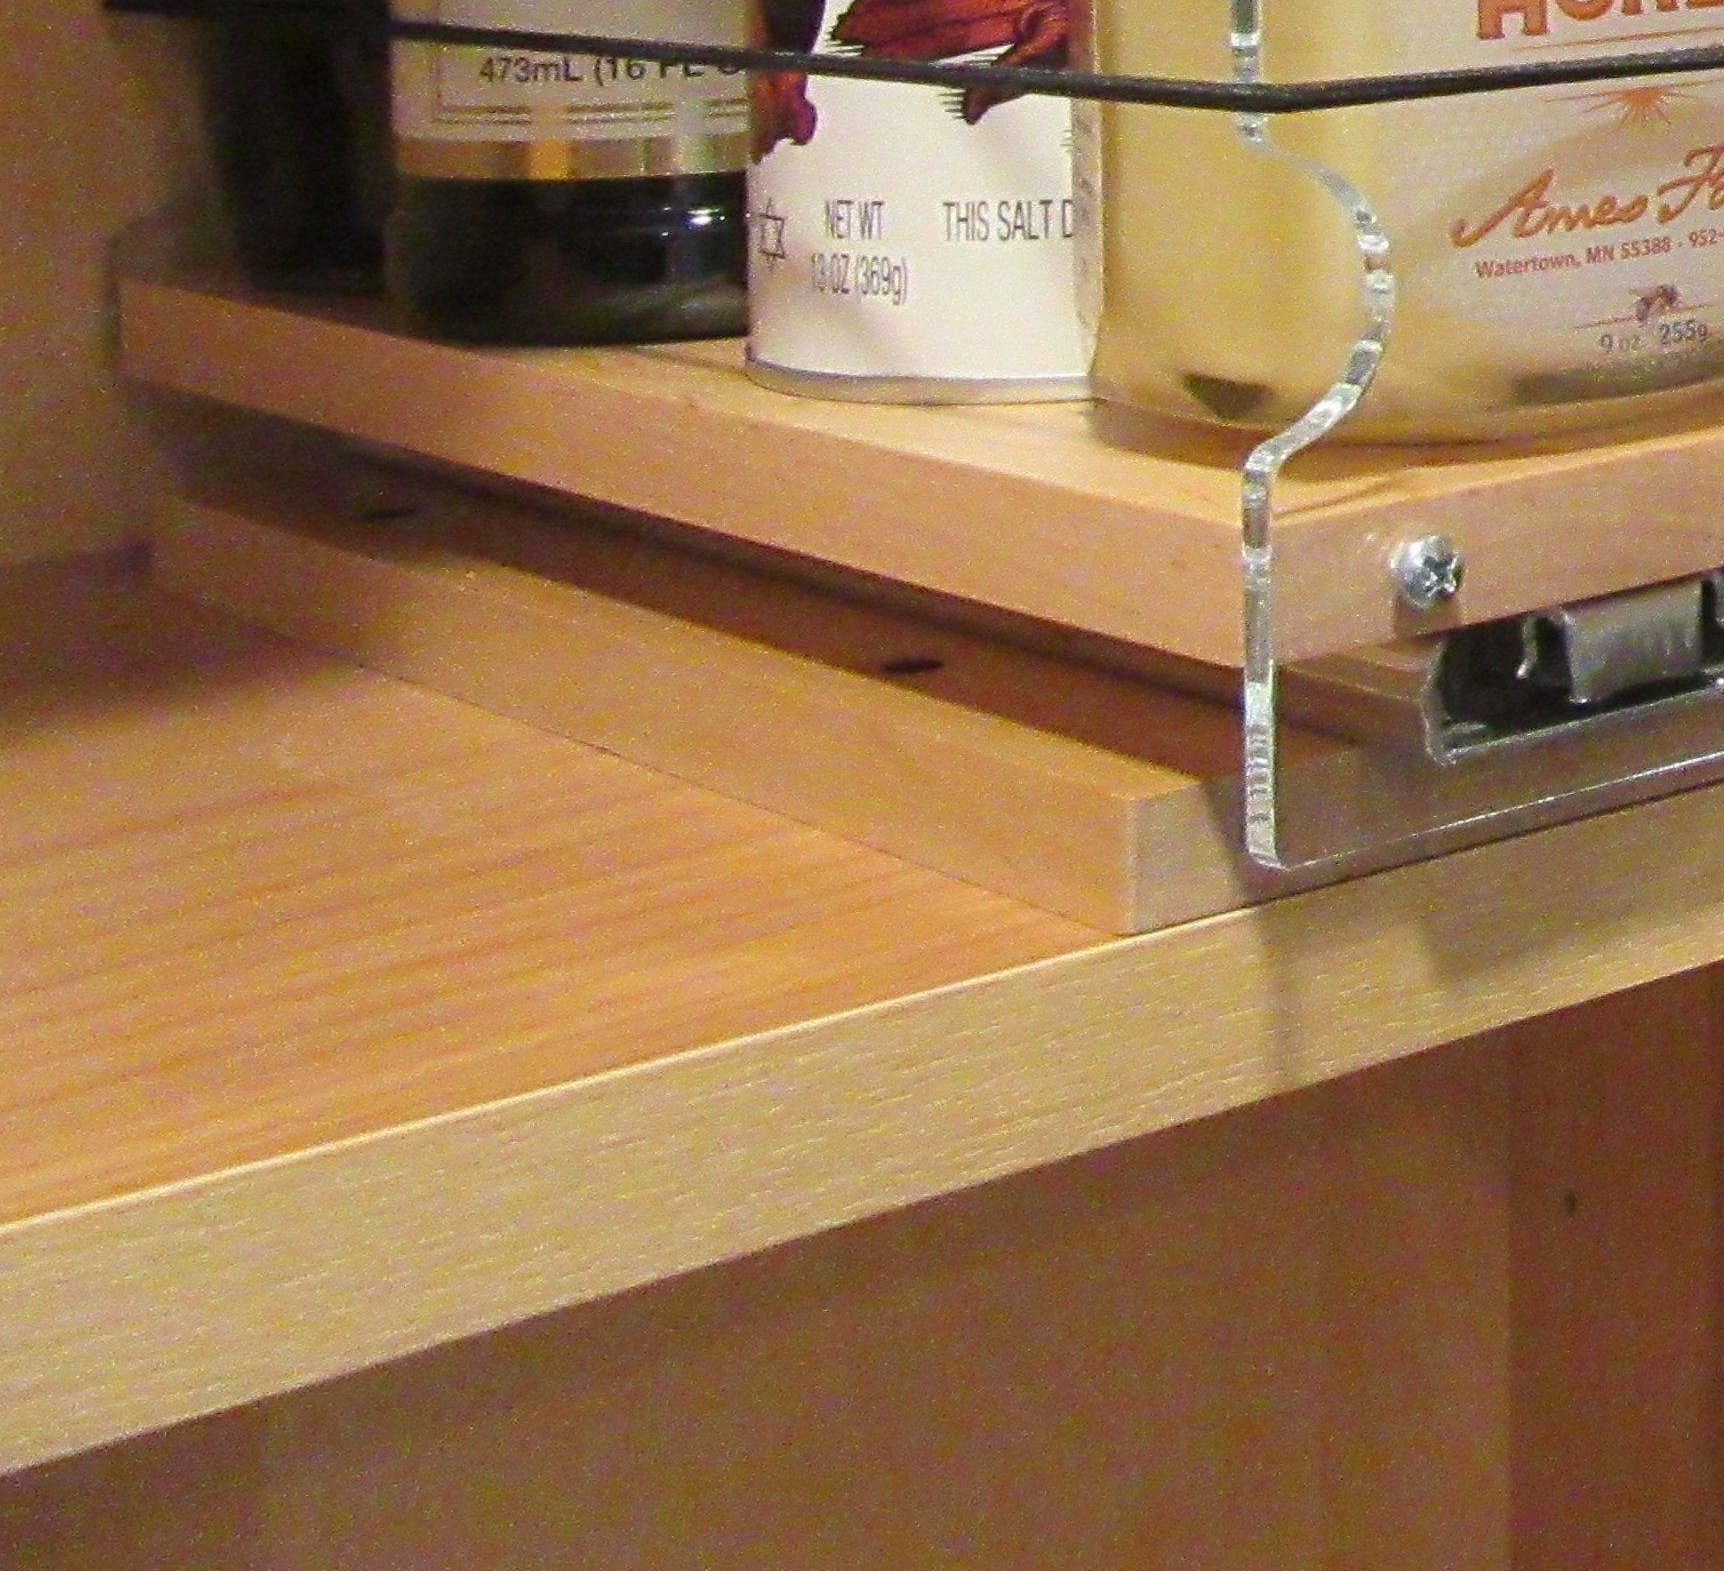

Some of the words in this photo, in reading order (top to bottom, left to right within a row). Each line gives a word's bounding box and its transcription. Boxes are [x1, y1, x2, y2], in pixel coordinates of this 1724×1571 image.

[479, 54, 584, 83] 473mL
[595, 52, 646, 87] (16
[824, 199, 854, 239] NET
[858, 201, 885, 240] WT
[942, 201, 990, 242] THIS
[997, 199, 1054, 240] SALT
[1450, 167, 1649, 247] Ames
[1475, 252, 1581, 279] Watertown,
[1586, 245, 1615, 266] MN
[1620, 234, 1672, 260] 55388
[855, 257, 908, 306] (369g)
[1600, 333, 1614, 355] 9
[1658, 318, 1709, 348] 255g
